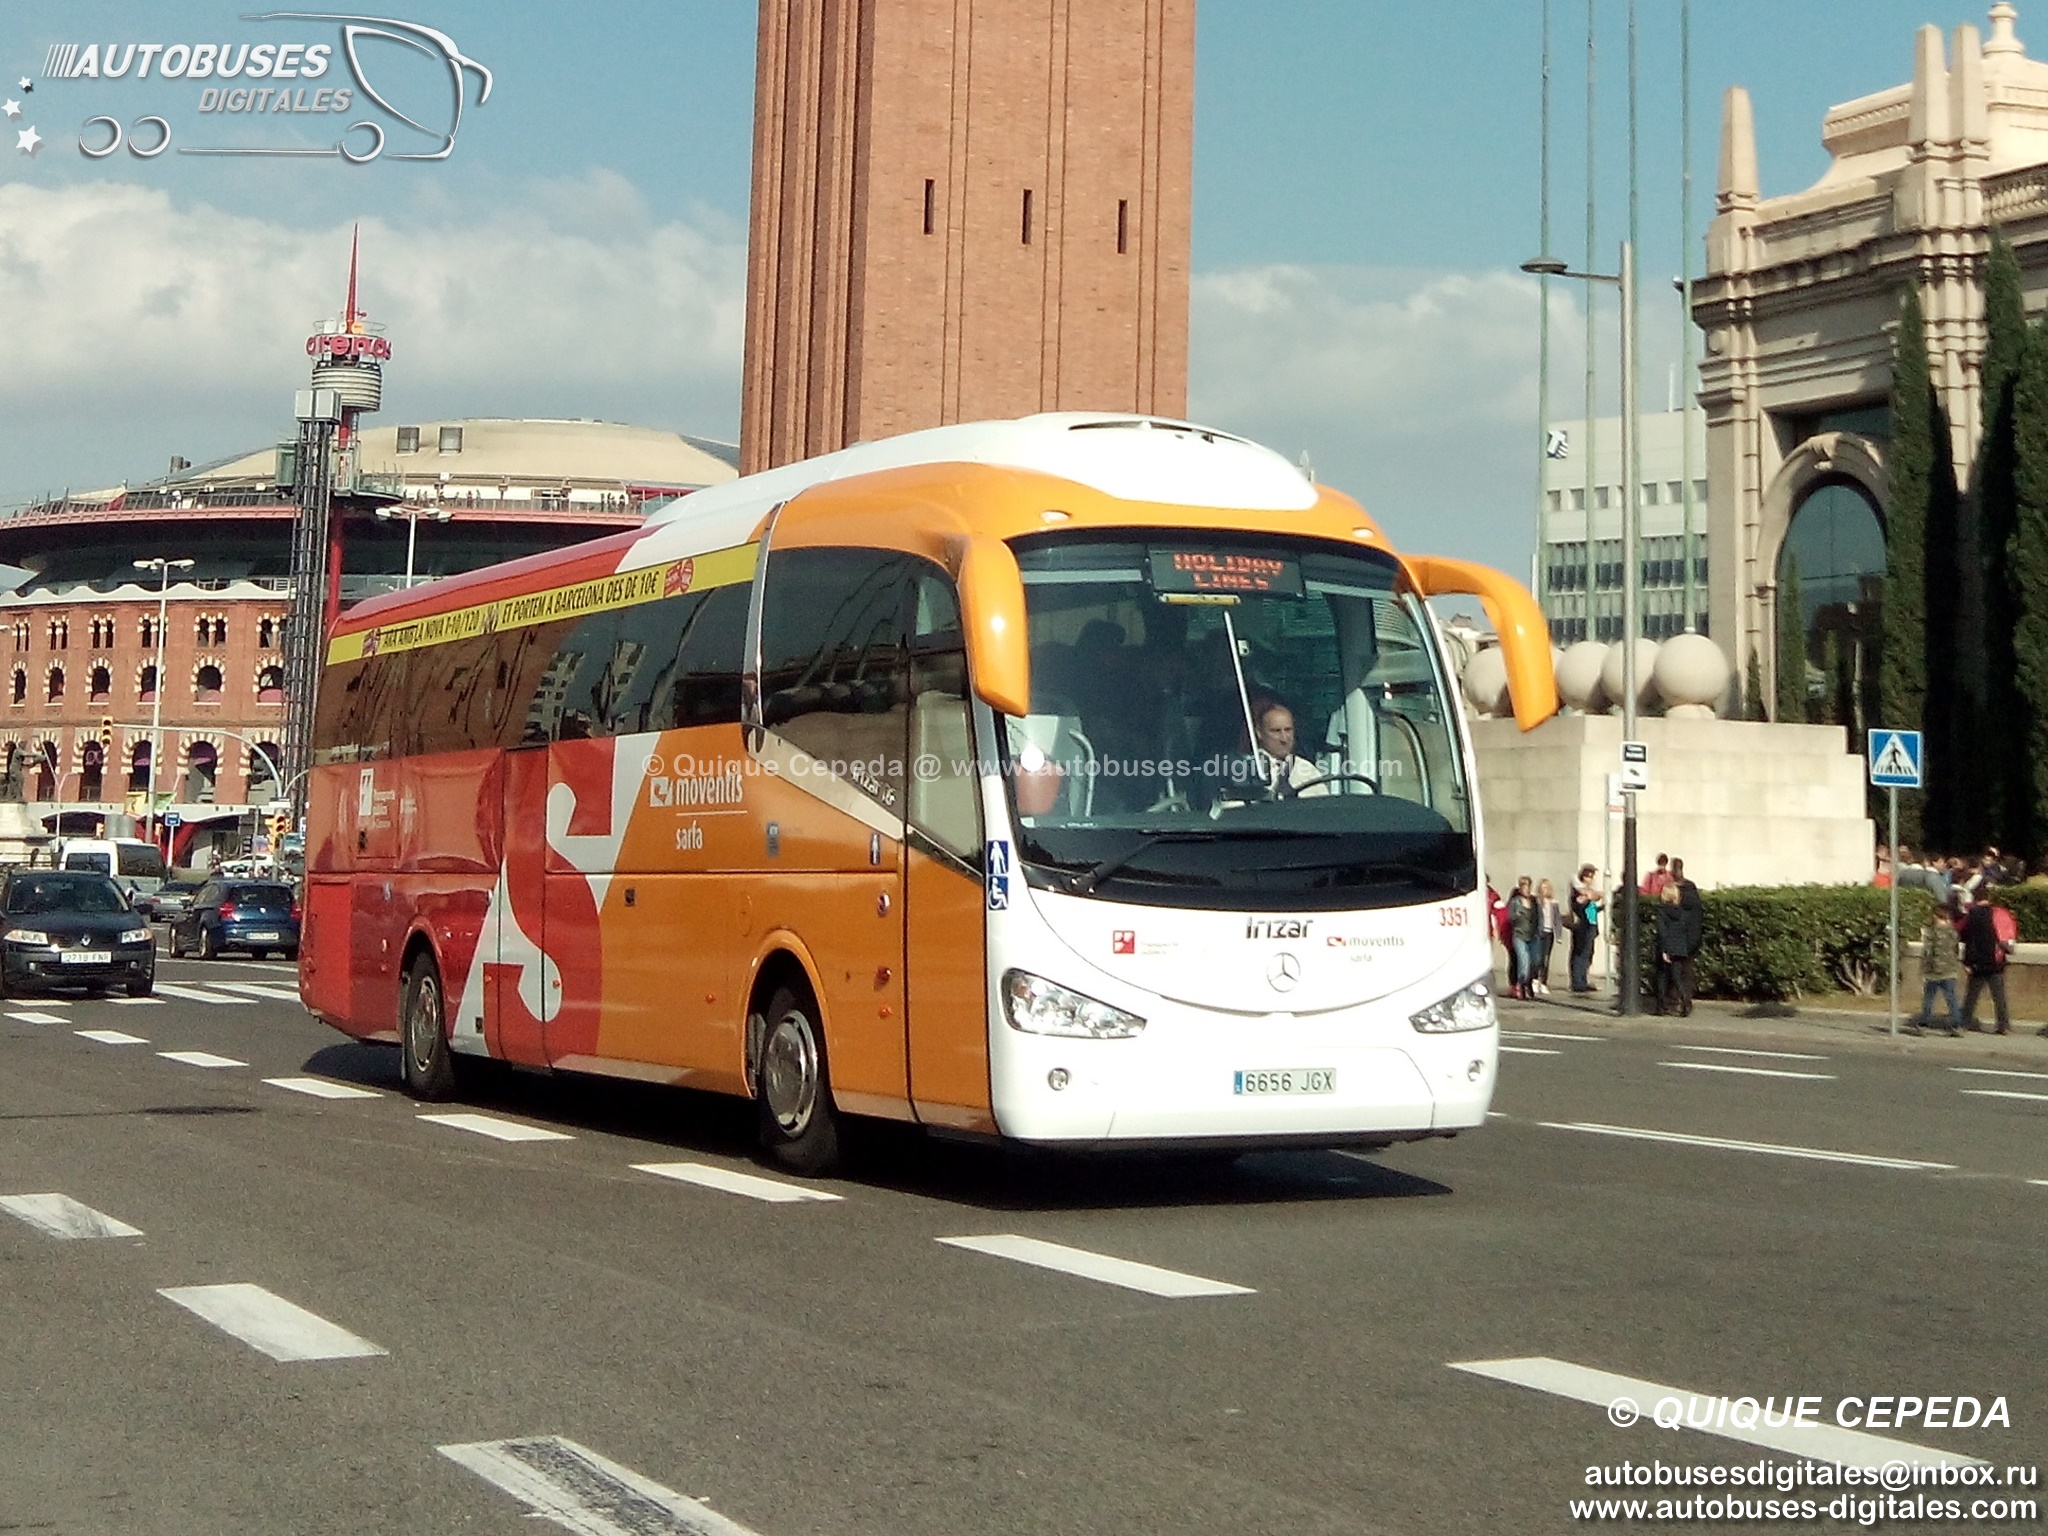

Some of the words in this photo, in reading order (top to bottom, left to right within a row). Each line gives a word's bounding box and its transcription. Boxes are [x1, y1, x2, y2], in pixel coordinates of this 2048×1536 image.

[1174, 553, 1284, 575] HOLIDAY
[502, 602, 512, 624] ET
[513, 594, 545, 622] PORTEM
[545, 593, 552, 615] A
[554, 582, 605, 614] BARCELONA
[605, 578, 623, 605] DES
[625, 575, 639, 599] DE
[675, 766, 744, 806] moventis
[675, 820, 704, 850] sarfa
[1439, 907, 1469, 926] 3351
[1349, 935, 1405, 947] moventis
[1245, 1072, 1292, 1092] 6656
[1300, 1071, 1333, 1091] JGX
